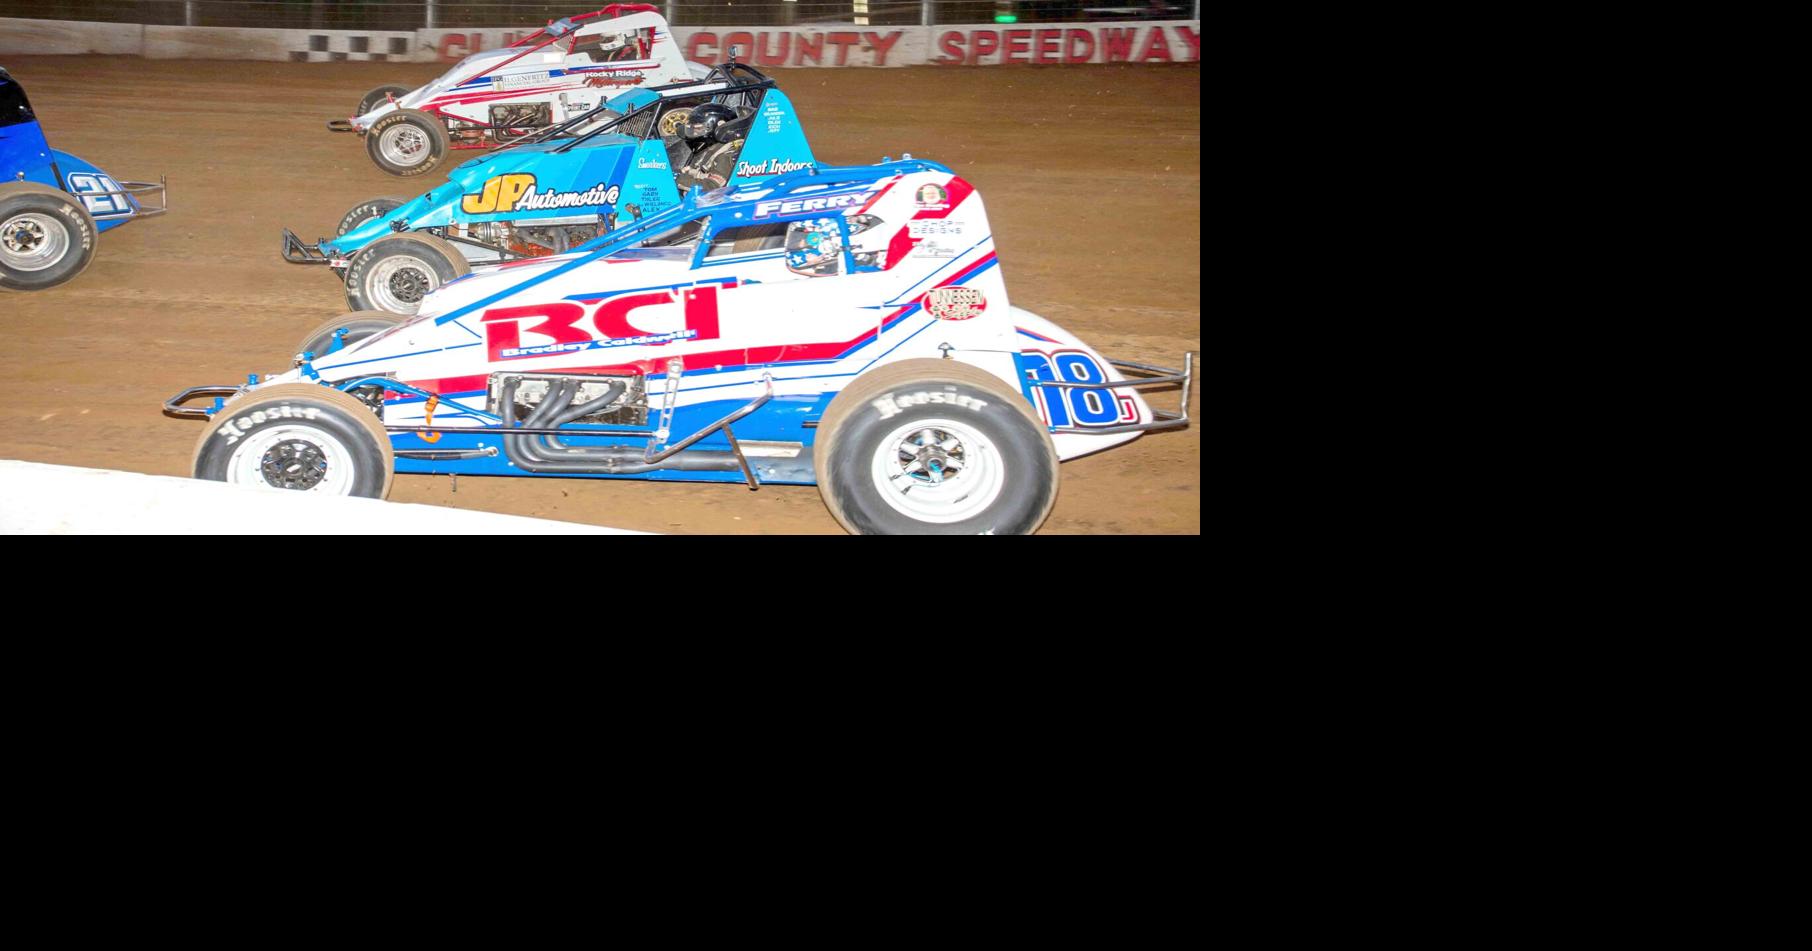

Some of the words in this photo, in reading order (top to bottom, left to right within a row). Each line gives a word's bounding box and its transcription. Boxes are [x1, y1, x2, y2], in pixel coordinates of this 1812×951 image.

[686, 31, 903, 66] COUNTY
[937, 26, 1200, 64] SPEEDWAY
[615, 70, 643, 78] Ridge
[737, 161, 767, 178] Shoot
[769, 158, 814, 175] Indoors
[68, 172, 134, 214] 21
[462, 173, 535, 213] JP
[515, 183, 619, 211] Automotive
[753, 190, 876, 219] FERRY
[502, 341, 594, 357] Bradley
